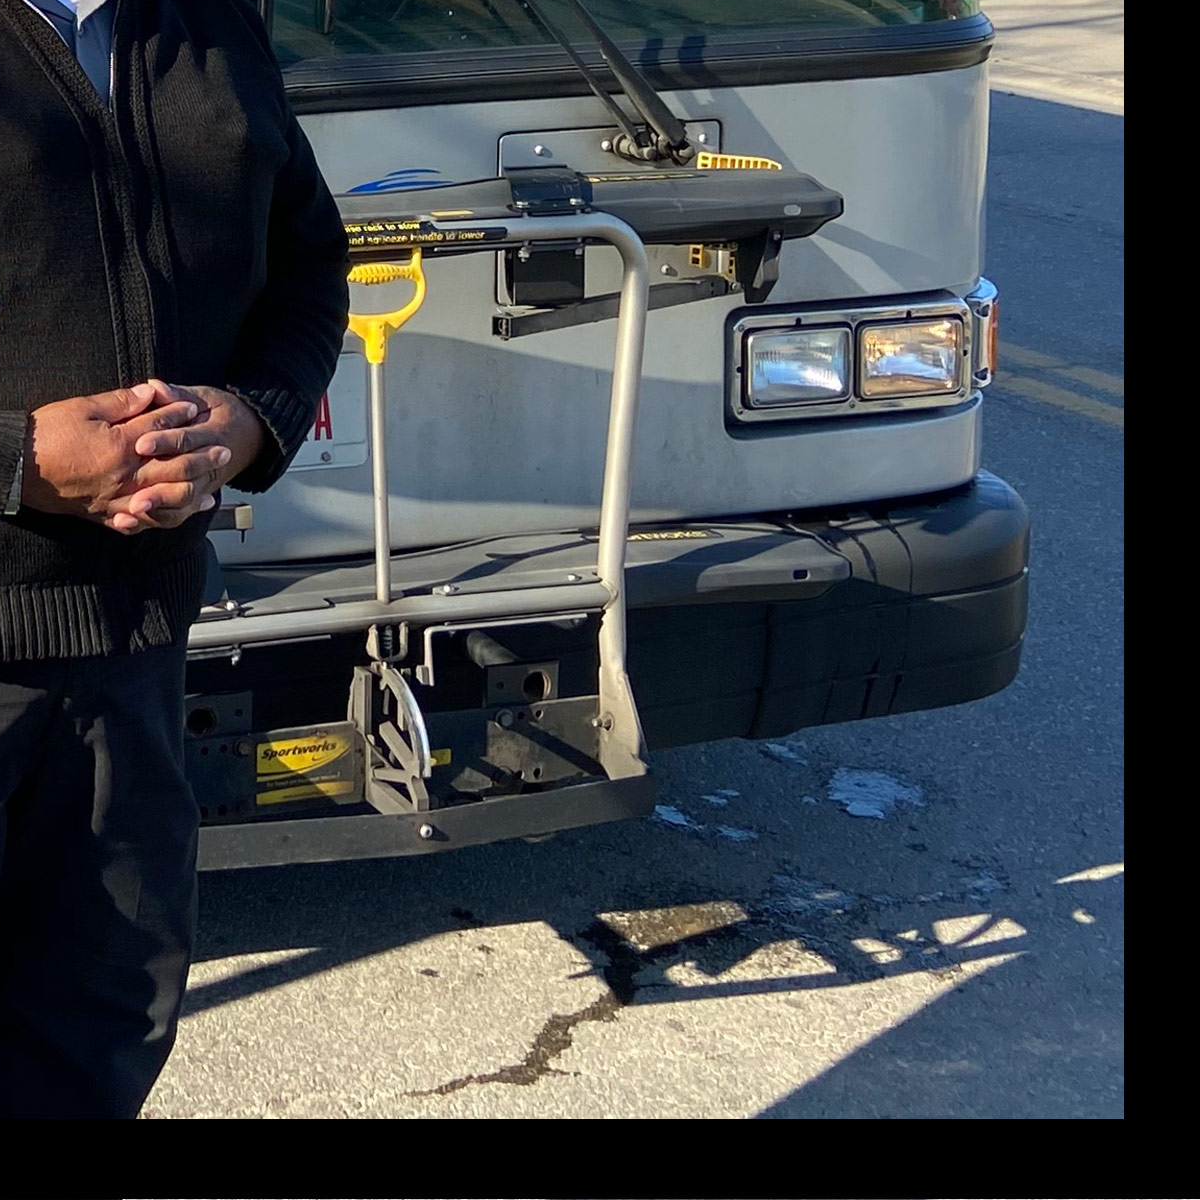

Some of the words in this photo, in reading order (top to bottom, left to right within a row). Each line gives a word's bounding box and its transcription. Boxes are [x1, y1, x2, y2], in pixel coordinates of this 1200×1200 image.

[385, 223, 396, 231] to
[445, 230, 456, 241] to
[458, 230, 486, 240] lower
[261, 740, 337, 760] Sportworks
